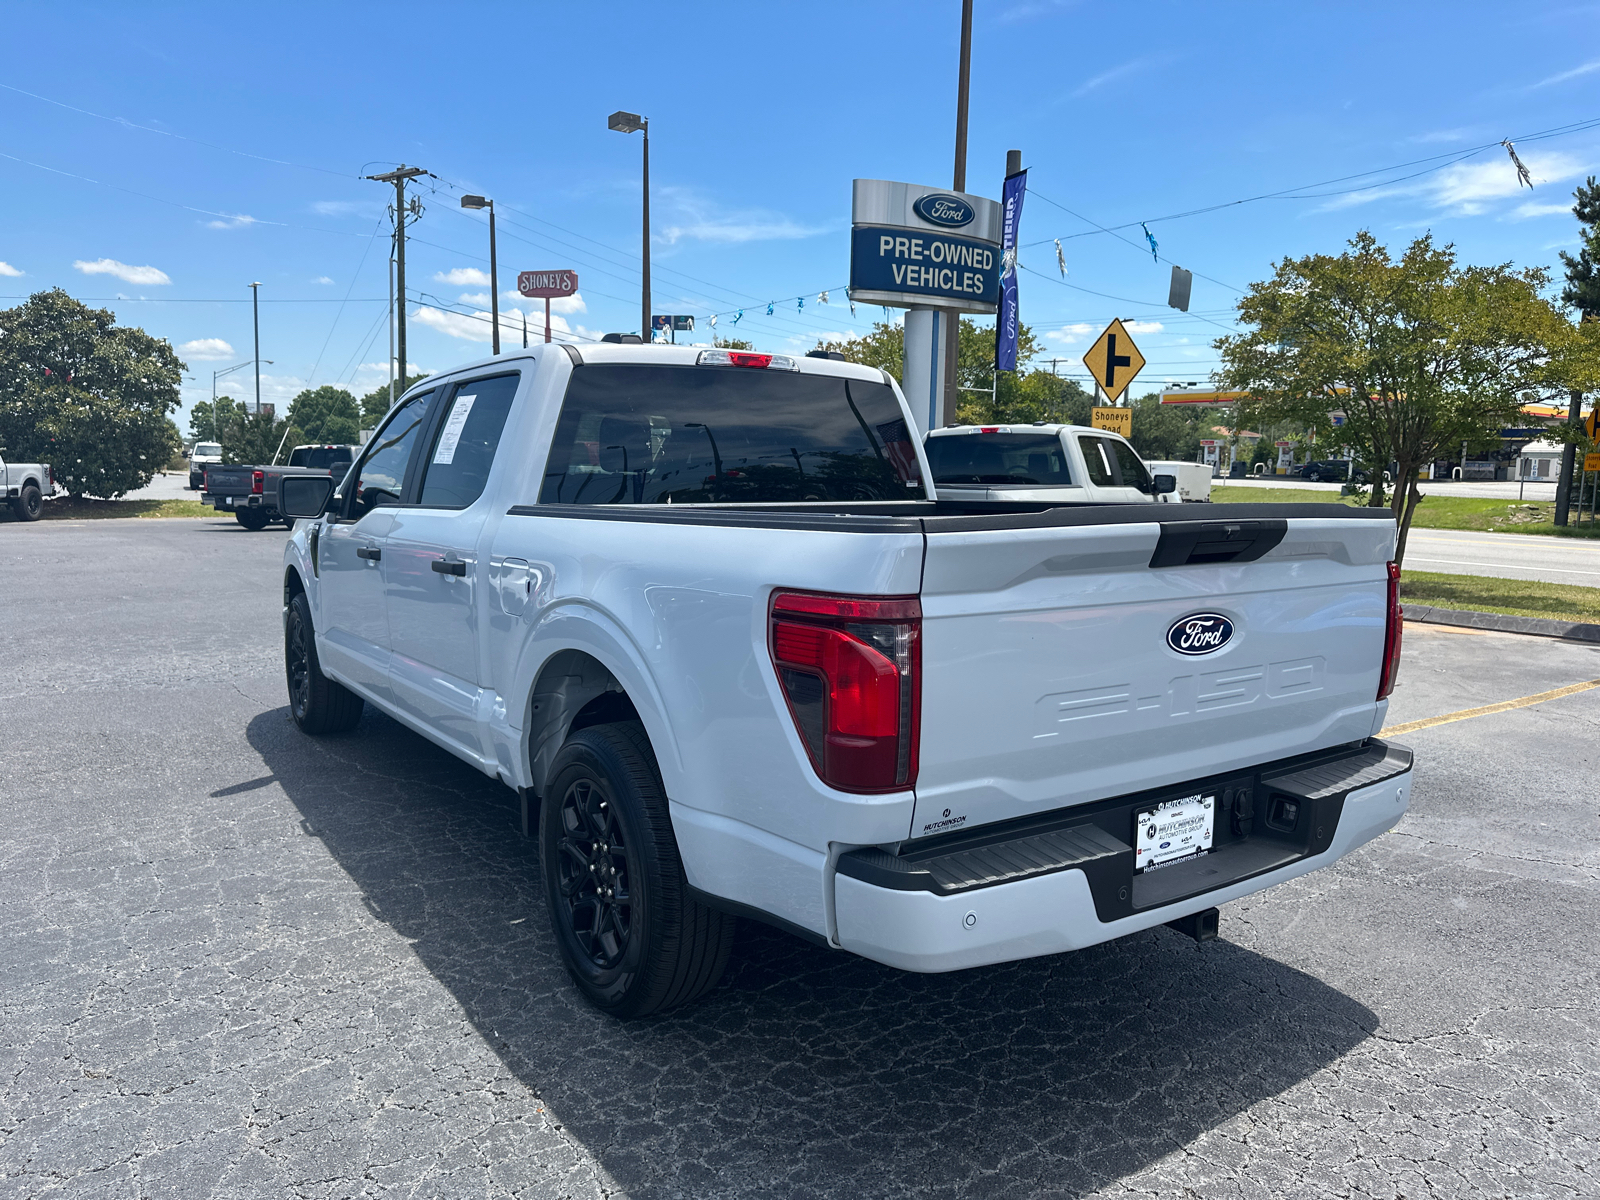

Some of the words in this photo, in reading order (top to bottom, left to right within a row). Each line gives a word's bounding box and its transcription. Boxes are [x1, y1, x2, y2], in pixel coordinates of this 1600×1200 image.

[931, 200, 964, 221] Ford
[879, 235, 993, 271] PRE-OWNED
[520, 272, 572, 292] SHONEY'S
[891, 263, 984, 294] VEHICLES
[1007, 300, 1016, 339] Ford
[1095, 411, 1129, 422] Shoneys
[1102, 424, 1121, 433] Road
[1180, 620, 1223, 649] Ford
[1033, 655, 1327, 739] F-150
[1165, 794, 1202, 809] HUTCHINSON
[923, 815, 967, 831] HUTCHINSON
[1158, 827, 1188, 840] AUTOMOTIVE
[1187, 823, 1203, 833] GROUP
